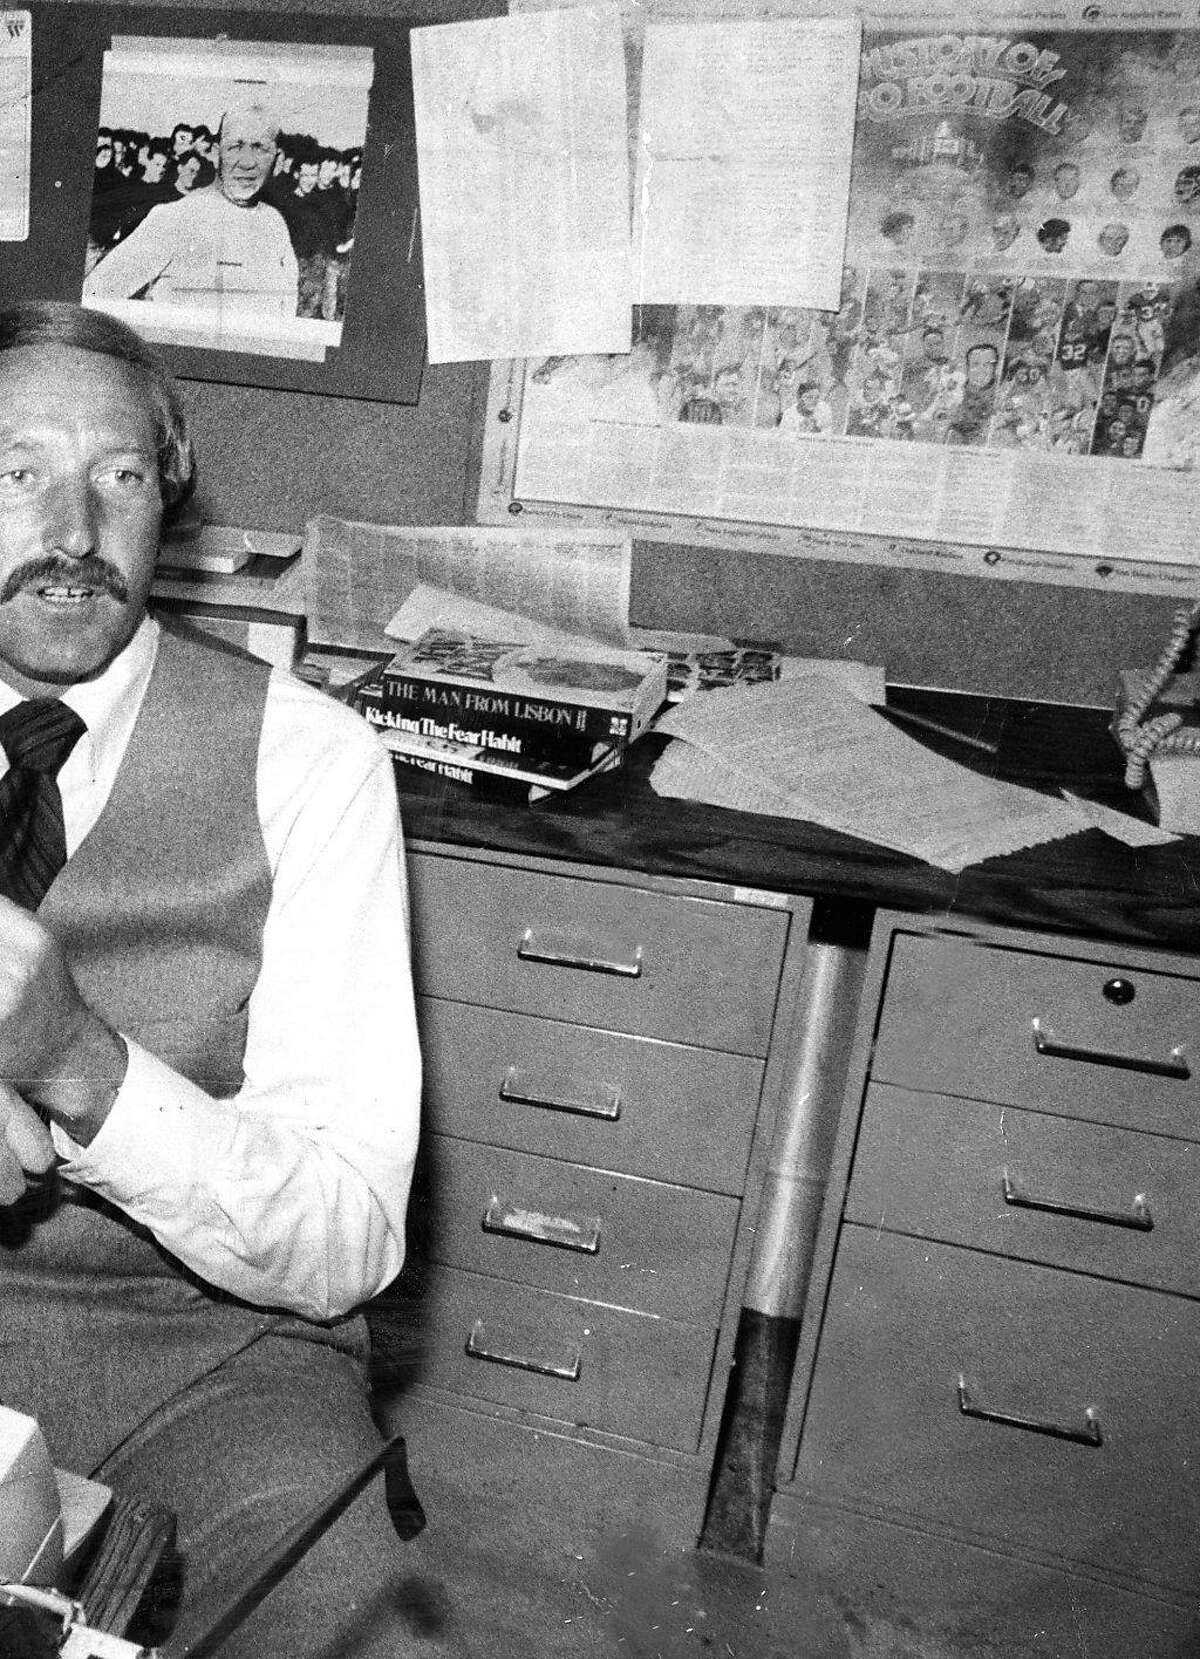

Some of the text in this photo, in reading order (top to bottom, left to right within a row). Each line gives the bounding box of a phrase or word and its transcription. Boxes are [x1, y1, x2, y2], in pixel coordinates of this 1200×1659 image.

[906, 73, 1069, 136] FOOTBALL
[1061, 343, 1087, 361] 32
[387, 681, 419, 700] THE
[422, 686, 462, 706] MAN
[465, 693, 511, 715] FROM
[514, 701, 573, 726] LISBON
[366, 706, 523, 754] Kicking The Fear Habit
